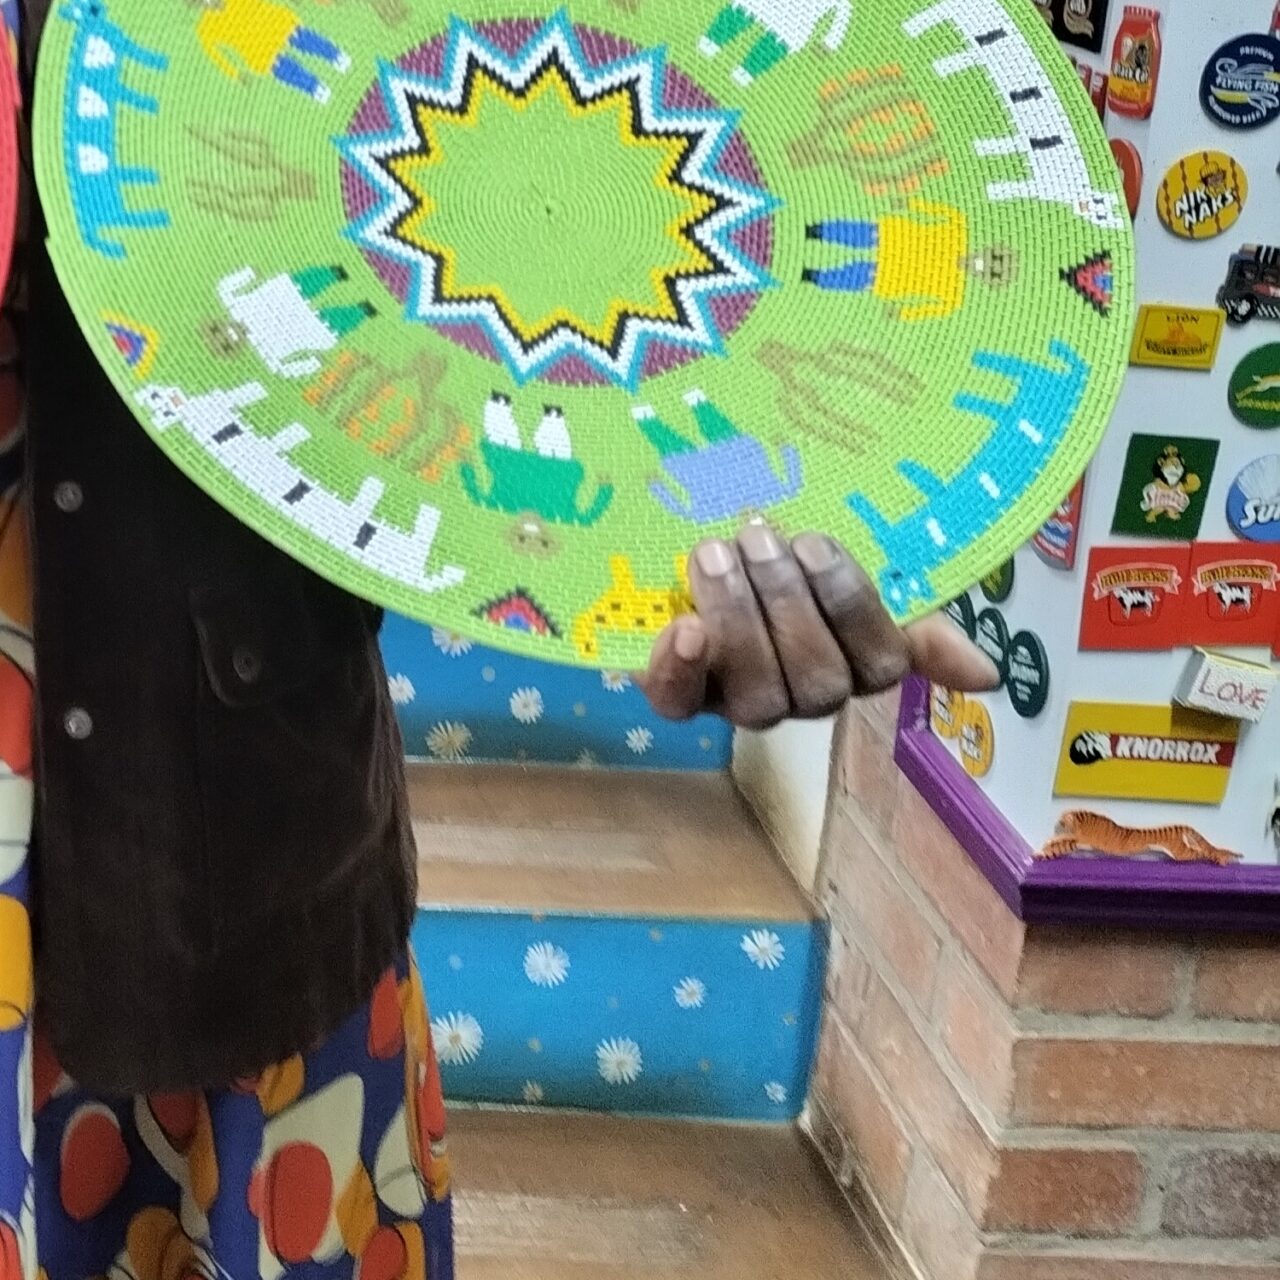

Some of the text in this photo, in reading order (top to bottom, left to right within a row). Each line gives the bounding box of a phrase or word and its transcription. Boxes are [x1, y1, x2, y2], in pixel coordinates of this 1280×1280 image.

[1215, 76, 1253, 91] FLYING
[1175, 186, 1208, 218] NIK
[1184, 188, 1234, 229] NAKS
[1197, 667, 1268, 710] LOVE
[1115, 735, 1222, 765] KNORROX
